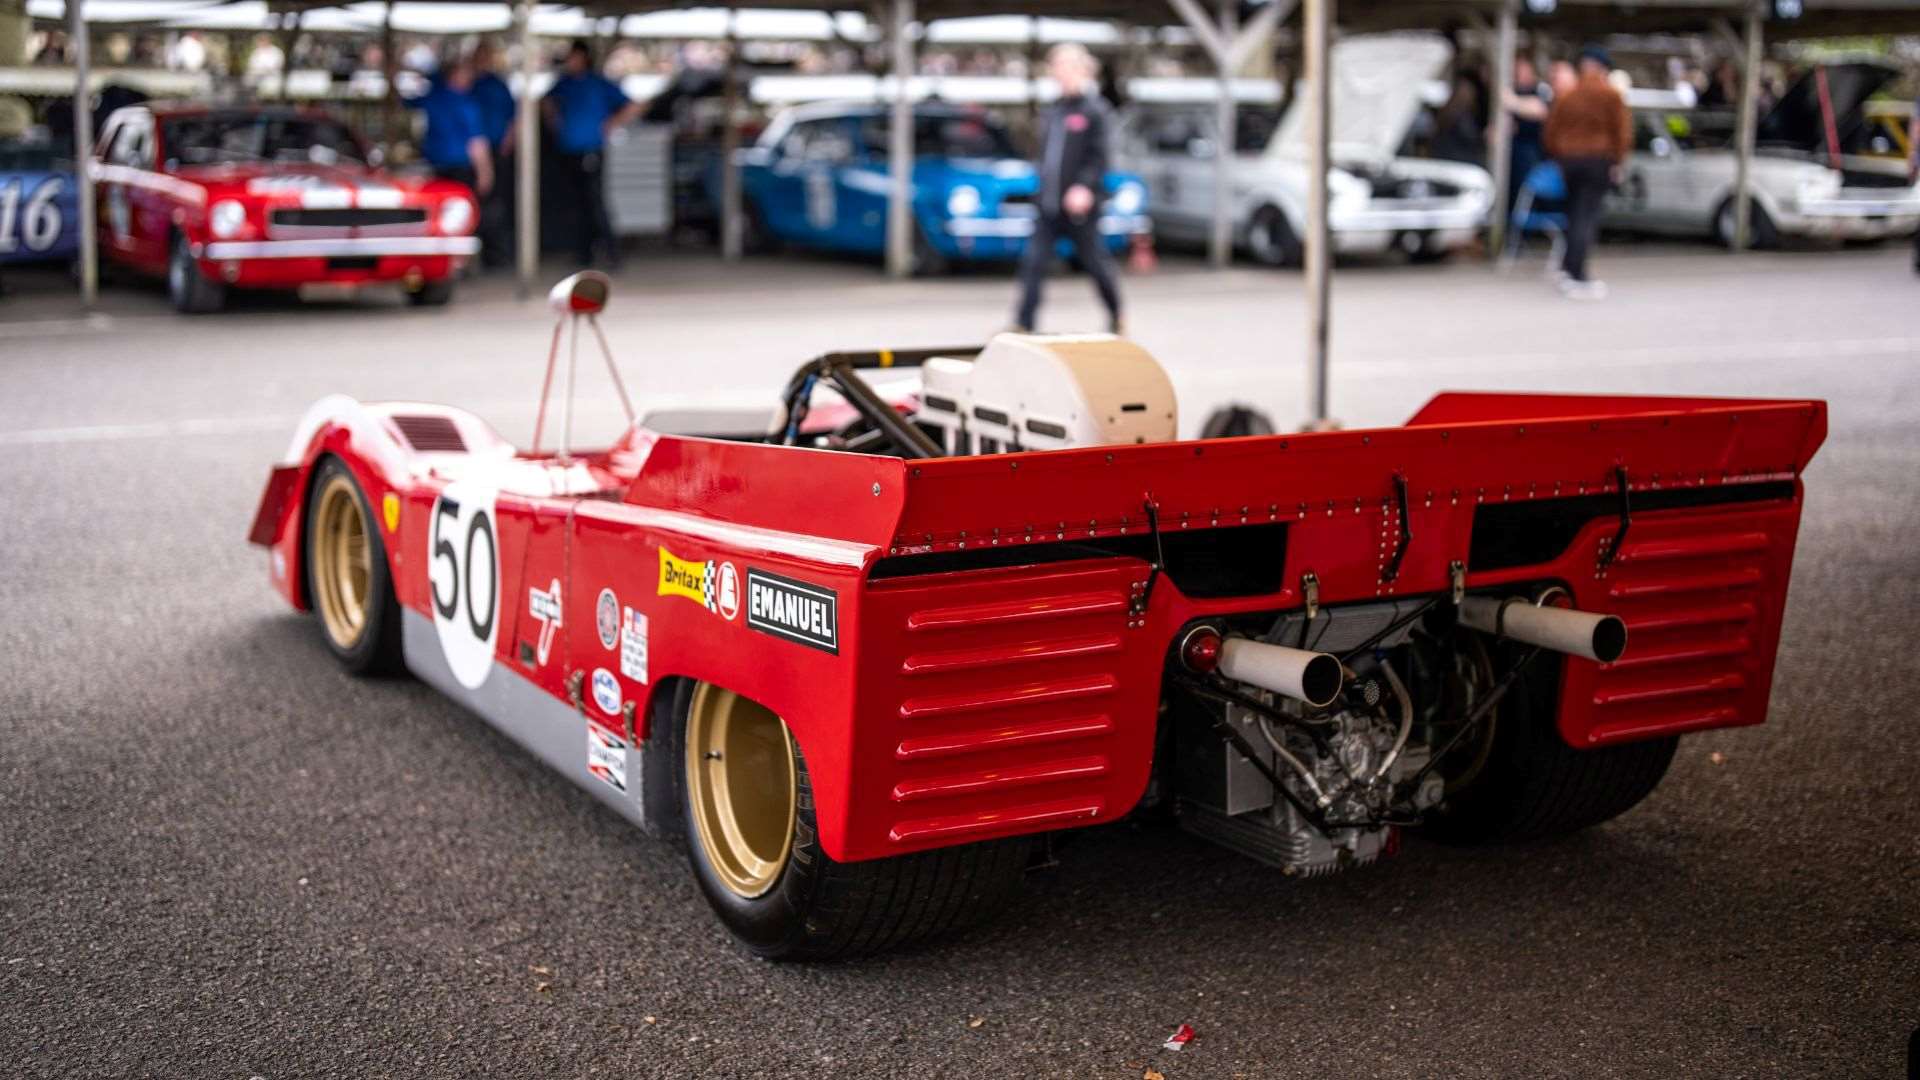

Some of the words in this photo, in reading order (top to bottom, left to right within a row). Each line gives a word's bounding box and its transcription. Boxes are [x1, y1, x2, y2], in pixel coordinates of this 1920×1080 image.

[0, 177, 64, 252] 16
[431, 496, 497, 642] 50
[665, 560, 702, 592] Britax
[751, 582, 832, 638] EMANUEL
